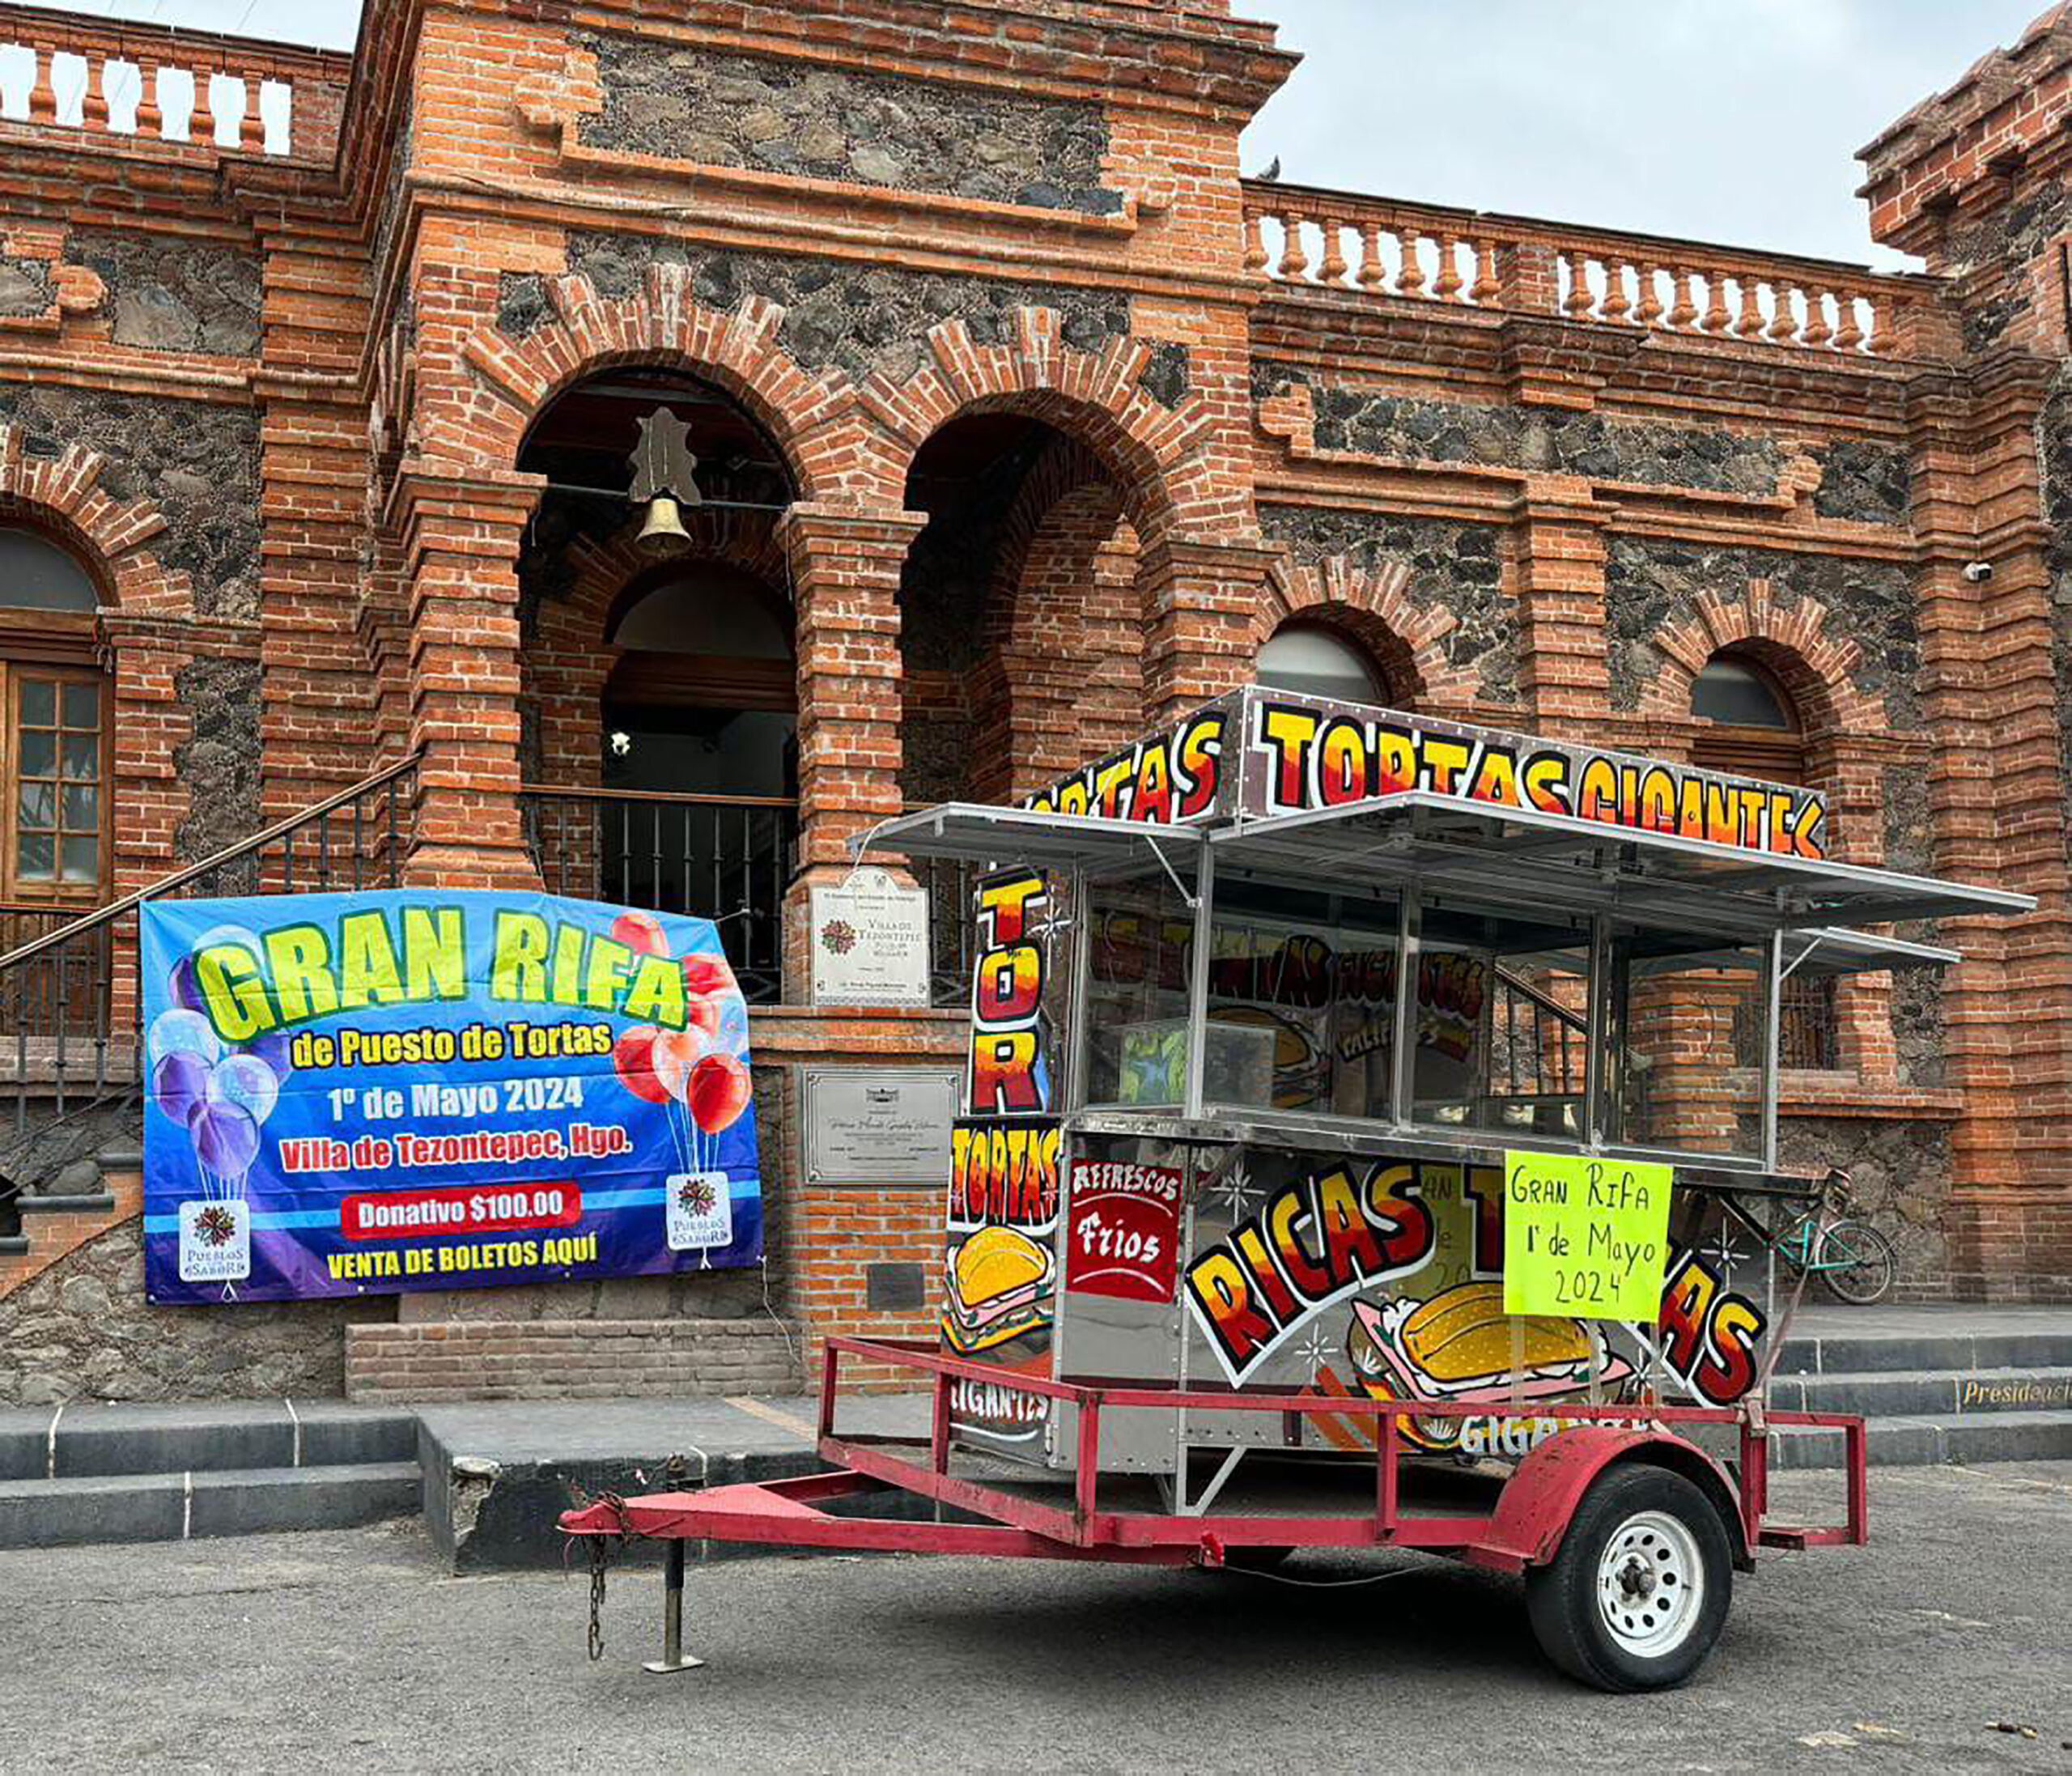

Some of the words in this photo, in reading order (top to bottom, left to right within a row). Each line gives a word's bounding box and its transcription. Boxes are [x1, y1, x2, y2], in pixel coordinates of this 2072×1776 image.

[1255, 703, 1574, 814] TORTAS
[192, 904, 469, 1044] GRAN
[490, 907, 690, 1032] RIFA
[292, 1029, 334, 1069] de
[338, 1026, 455, 1066] Puesto
[461, 1022, 504, 1061] de
[506, 1021, 613, 1060] Tortas
[363, 1086, 405, 1120] de
[410, 1083, 499, 1118] Mayo
[503, 1076, 584, 1113] 2024
[279, 1137, 350, 1172] Villa
[352, 1135, 393, 1171] de
[393, 1130, 568, 1167] Tezontepec,
[569, 1122, 634, 1158] Hgo.
[949, 1122, 1062, 1226] TORTAS
[1072, 1163, 1179, 1200] REFRESCOS
[1511, 1164, 1568, 1205] GRAN
[359, 1199, 465, 1229] Donativo
[469, 1190, 563, 1222] $100.00
[327, 1251, 401, 1280] VENTA
[405, 1247, 434, 1274] DE
[439, 1240, 538, 1272] BOLETOS
[542, 1231, 597, 1265] AQUÍ
[1185, 1162, 1434, 1383] RICAS
[1548, 1221, 1570, 1256] de
[1588, 1222, 1656, 1277] Mayo
[1555, 1269, 1620, 1304] 2024
[1963, 1378, 2072, 1405] Presidenci
